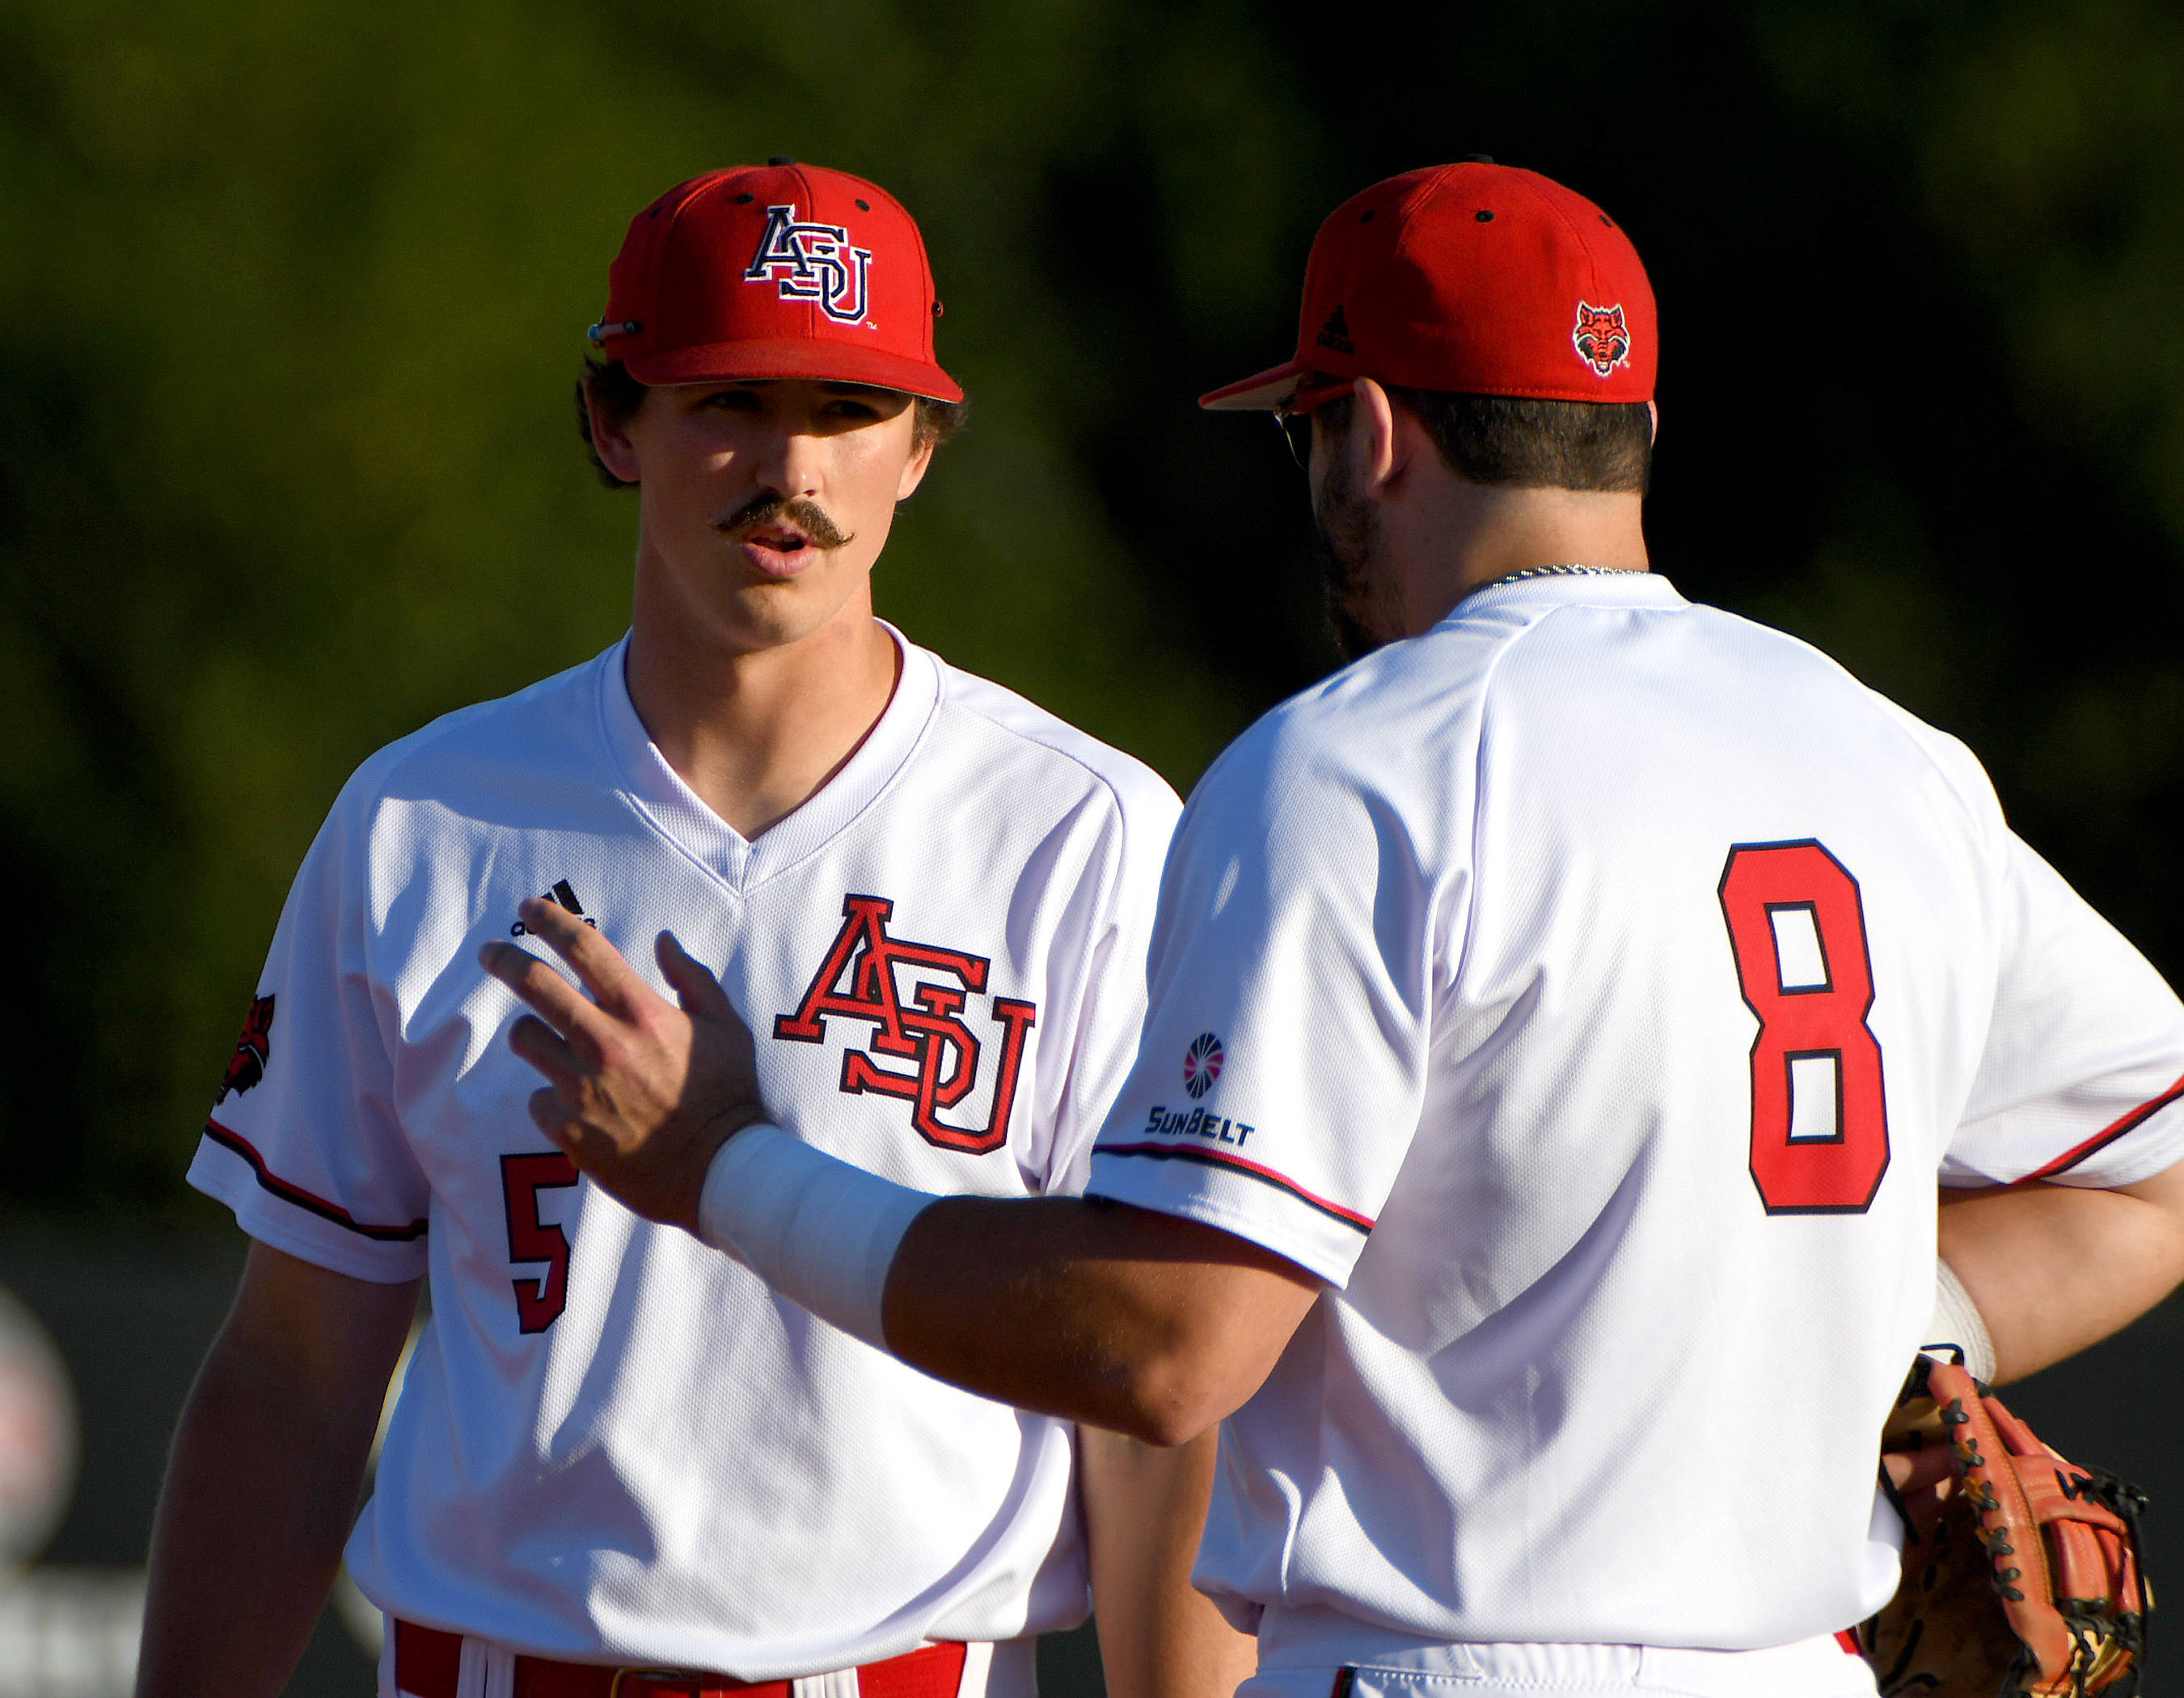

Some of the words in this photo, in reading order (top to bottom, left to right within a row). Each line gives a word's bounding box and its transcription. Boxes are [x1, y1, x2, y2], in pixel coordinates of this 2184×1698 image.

[744, 204, 872, 325] ASU
[773, 893, 1036, 1155] ASU
[1717, 838, 1890, 1216] 8
[500, 1151, 581, 1334] 5
